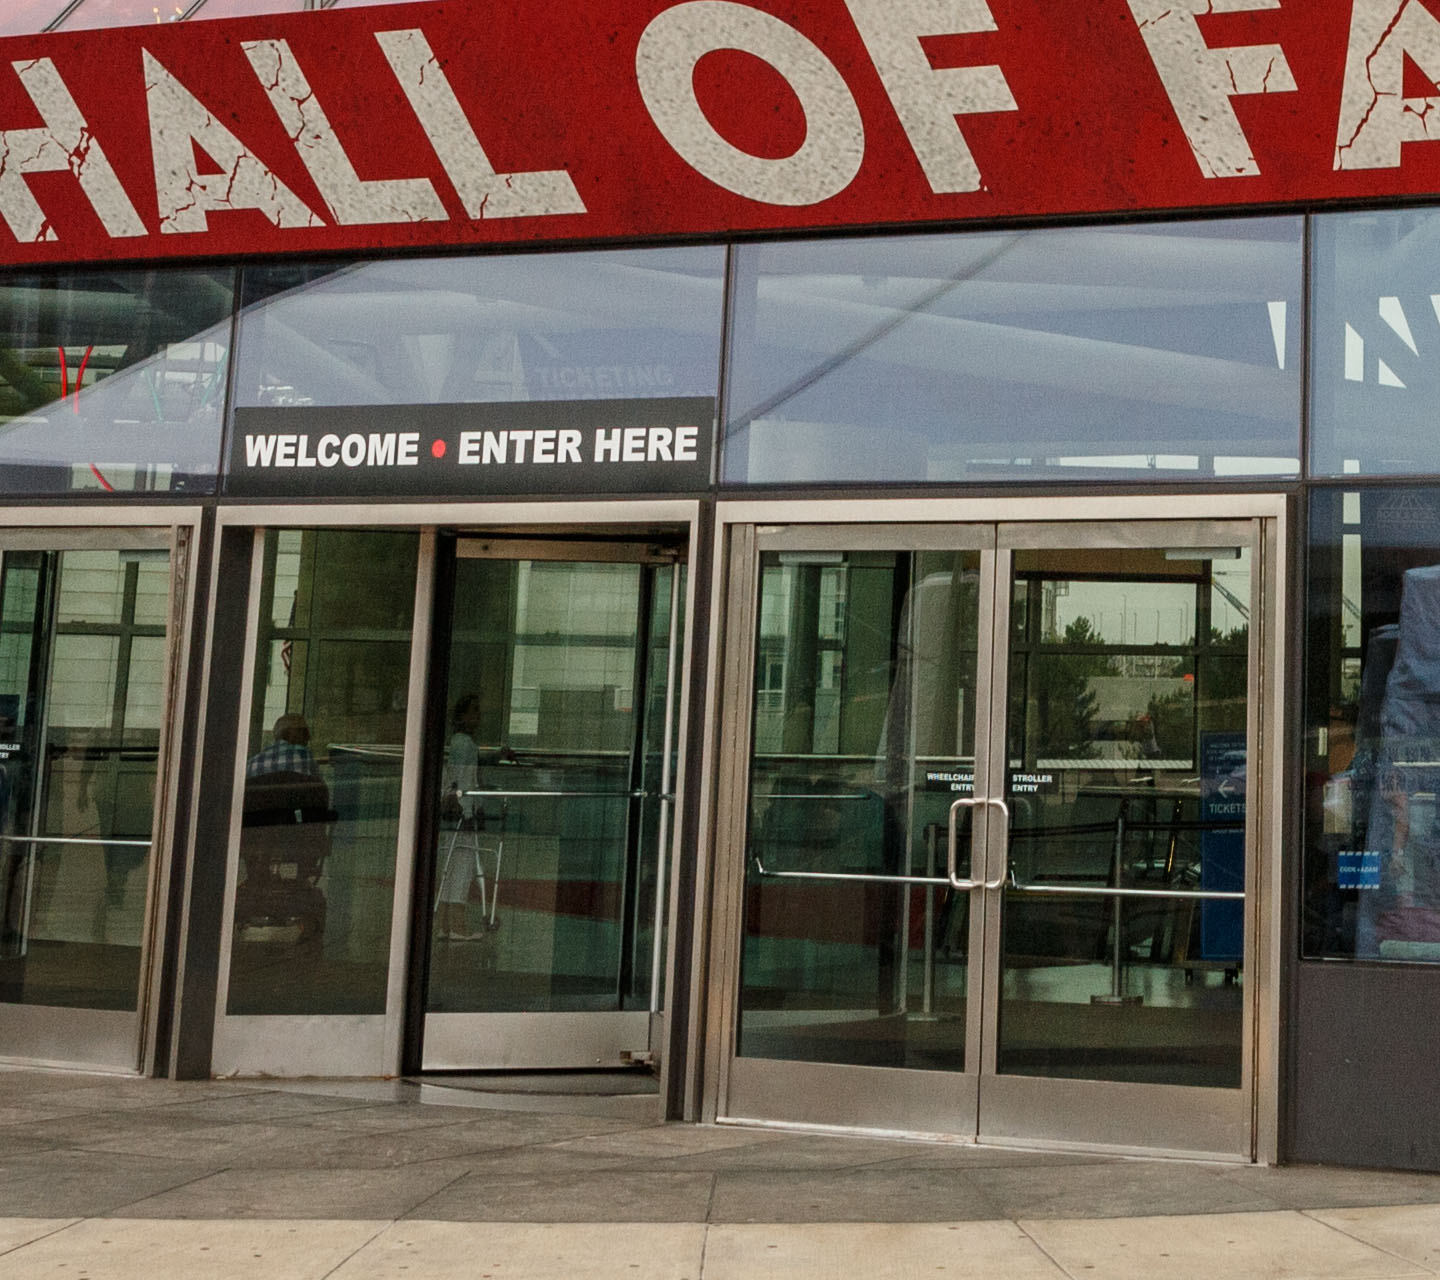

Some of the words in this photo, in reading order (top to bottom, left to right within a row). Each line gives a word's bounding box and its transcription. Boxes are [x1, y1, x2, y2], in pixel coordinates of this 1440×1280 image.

[245, 432, 420, 468] WELCOME
[458, 429, 583, 465] ENTER
[594, 426, 699, 463] HERE
[1012, 774, 1053, 782] STROLLER
[1012, 784, 1039, 792] ENTRY
